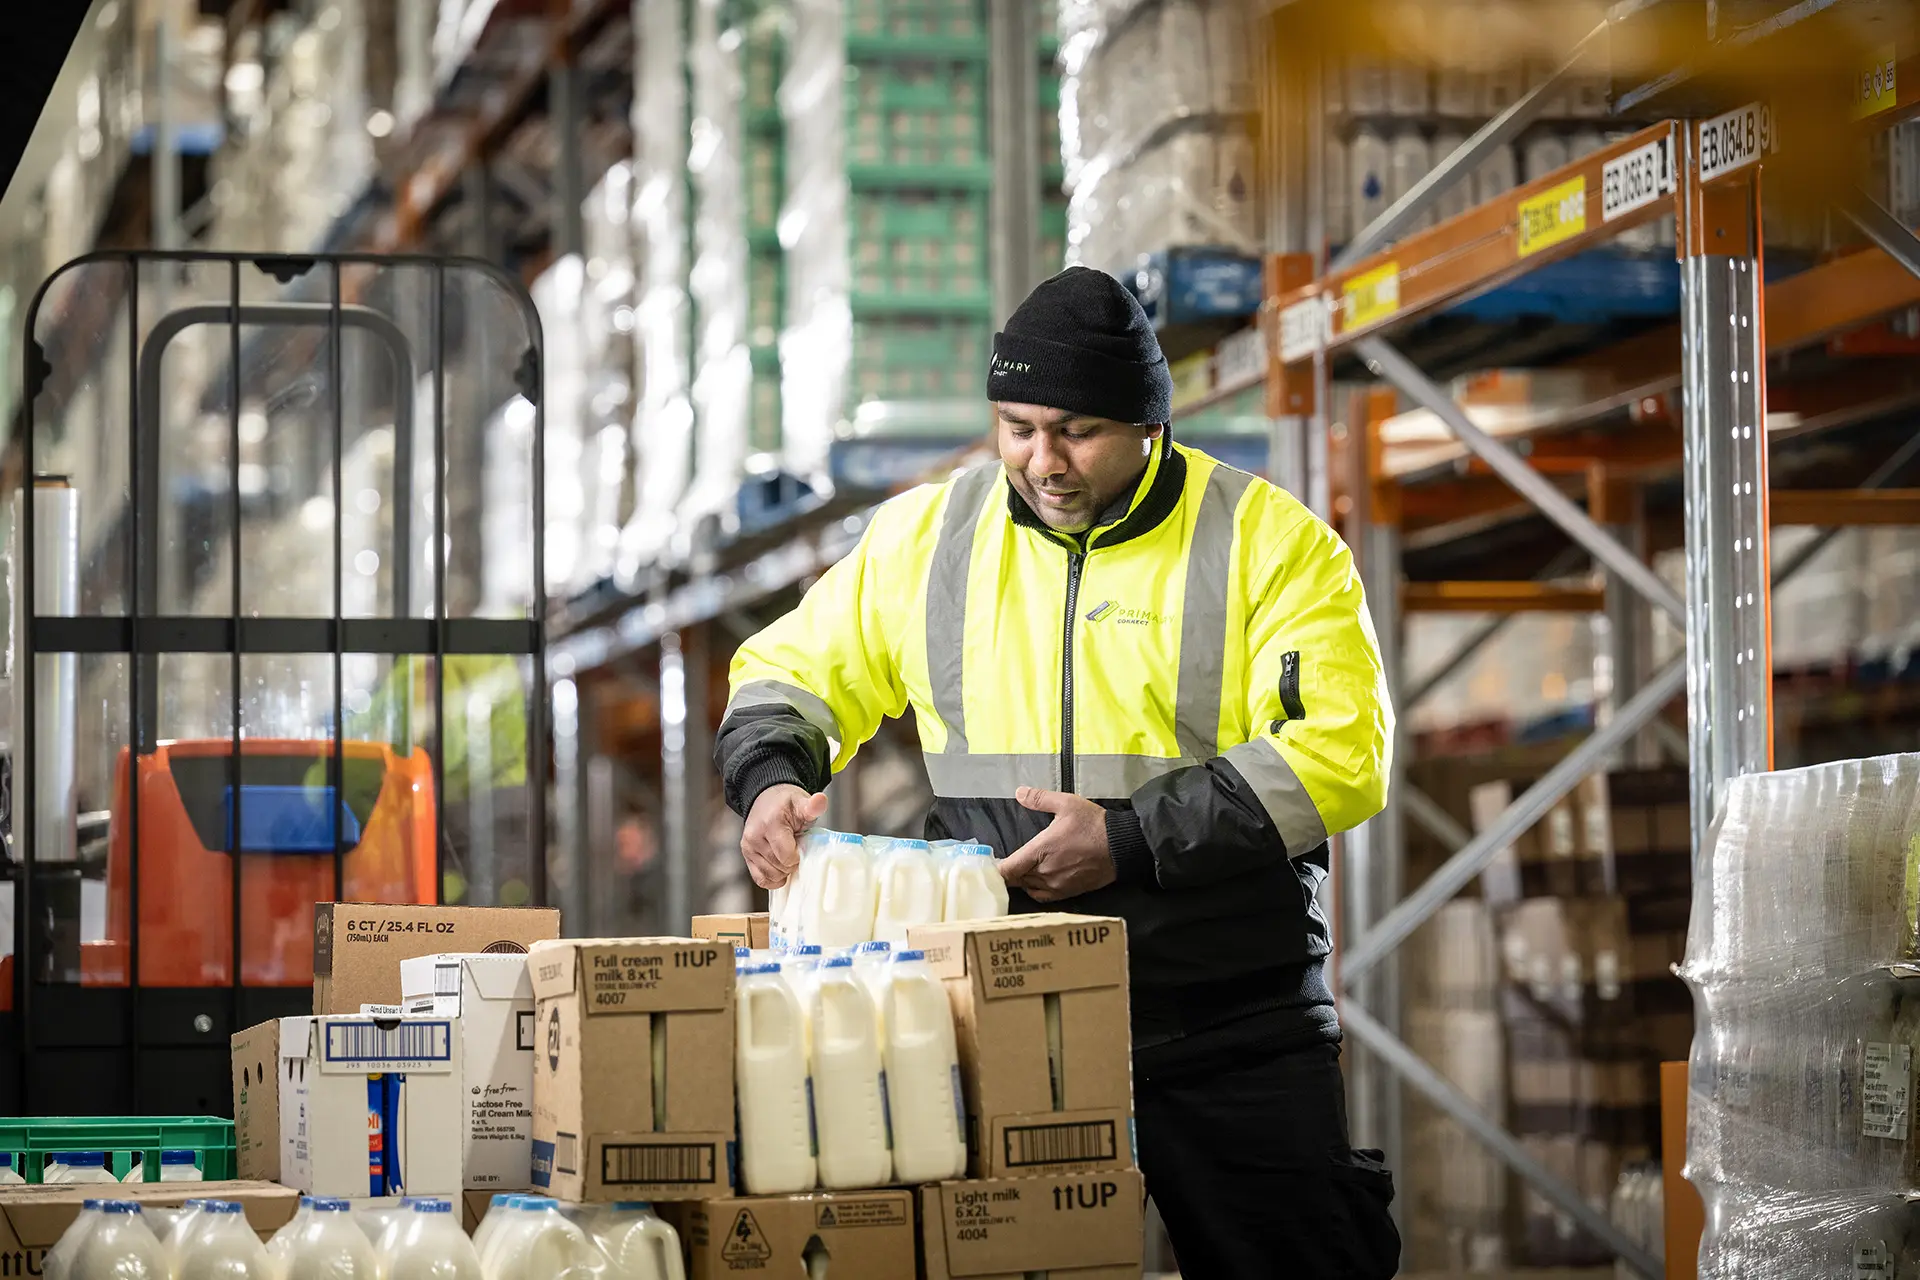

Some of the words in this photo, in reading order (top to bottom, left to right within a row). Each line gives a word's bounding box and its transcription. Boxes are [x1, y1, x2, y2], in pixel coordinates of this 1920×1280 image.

[1702, 112, 1756, 172] EB.054.B
[1761, 105, 1770, 150] 9
[1117, 618, 1149, 626] CONNECT
[347, 920, 355, 931] 6
[359, 920, 376, 931] CT
[386, 921, 414, 932] 25.4
[417, 922, 433, 933] FL
[436, 922, 455, 933] OZ
[373, 934, 389, 942] EACH
[1083, 926, 1110, 945] UP
[989, 938, 1024, 954] Light
[1027, 934, 1055, 948] milk
[594, 955, 618, 968] Full
[622, 955, 663, 967] cream
[690, 950, 718, 967] UP
[595, 969, 624, 982] milk
[991, 966, 1013, 975] STORE
[1015, 964, 1039, 973] BELOW
[994, 975, 1025, 990] 4008
[596, 992, 626, 1004] 4007
[471, 1100, 503, 1108] Lactose
[505, 1100, 523, 1108] Free
[954, 1190, 988, 1206] Light
[992, 1188, 1020, 1201] milk
[1077, 1181, 1117, 1209] UP
[956, 1219, 978, 1227] STORE
[979, 1217, 1003, 1225] BELOW
[957, 1228, 988, 1241] 4004
[26, 1251, 46, 1275] U
